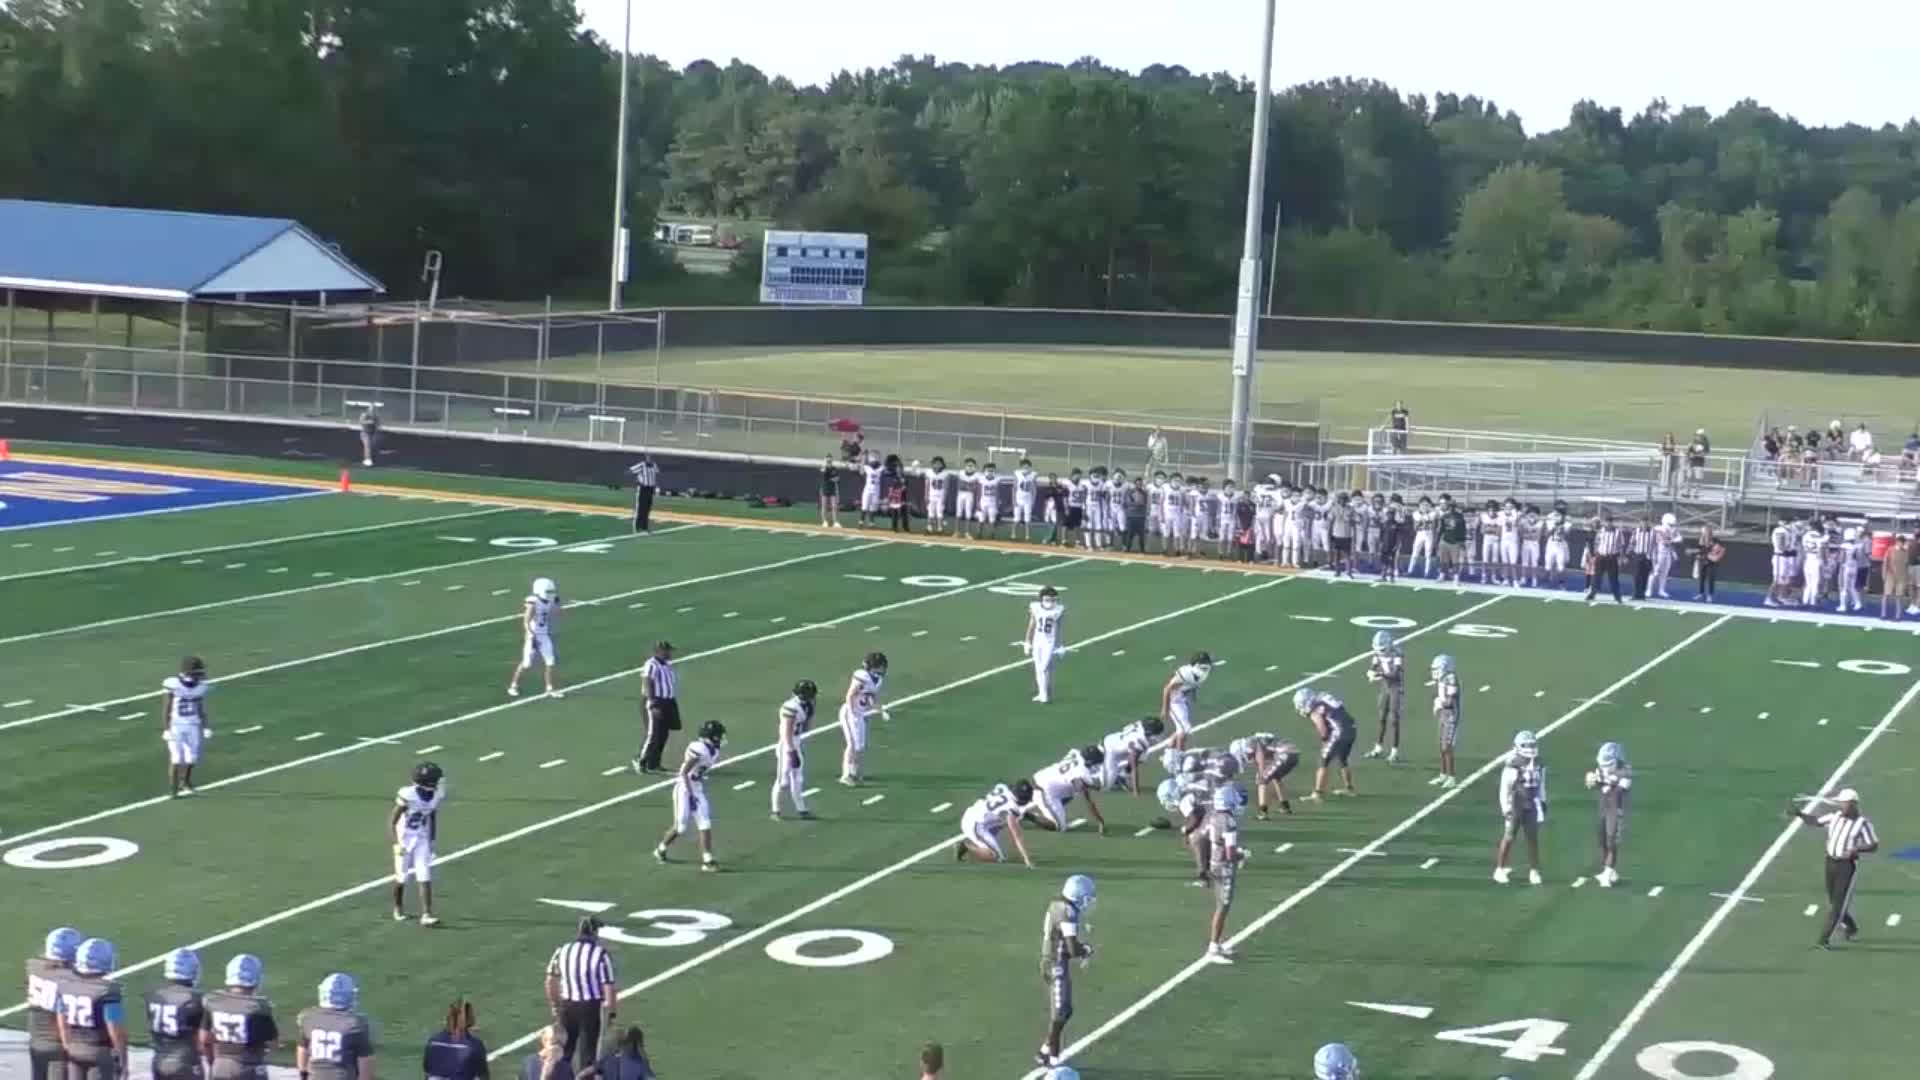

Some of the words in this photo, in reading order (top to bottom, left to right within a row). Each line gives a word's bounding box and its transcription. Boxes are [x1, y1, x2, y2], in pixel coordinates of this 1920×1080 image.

[2, 836, 140, 870] 0
[598, 908, 895, 968] 30
[62, 993, 95, 1027] 72
[149, 1002, 178, 1036] 75
[212, 1011, 249, 1043] 53
[311, 1029, 342, 1062] 62
[1434, 1017, 1776, 1080] 40
